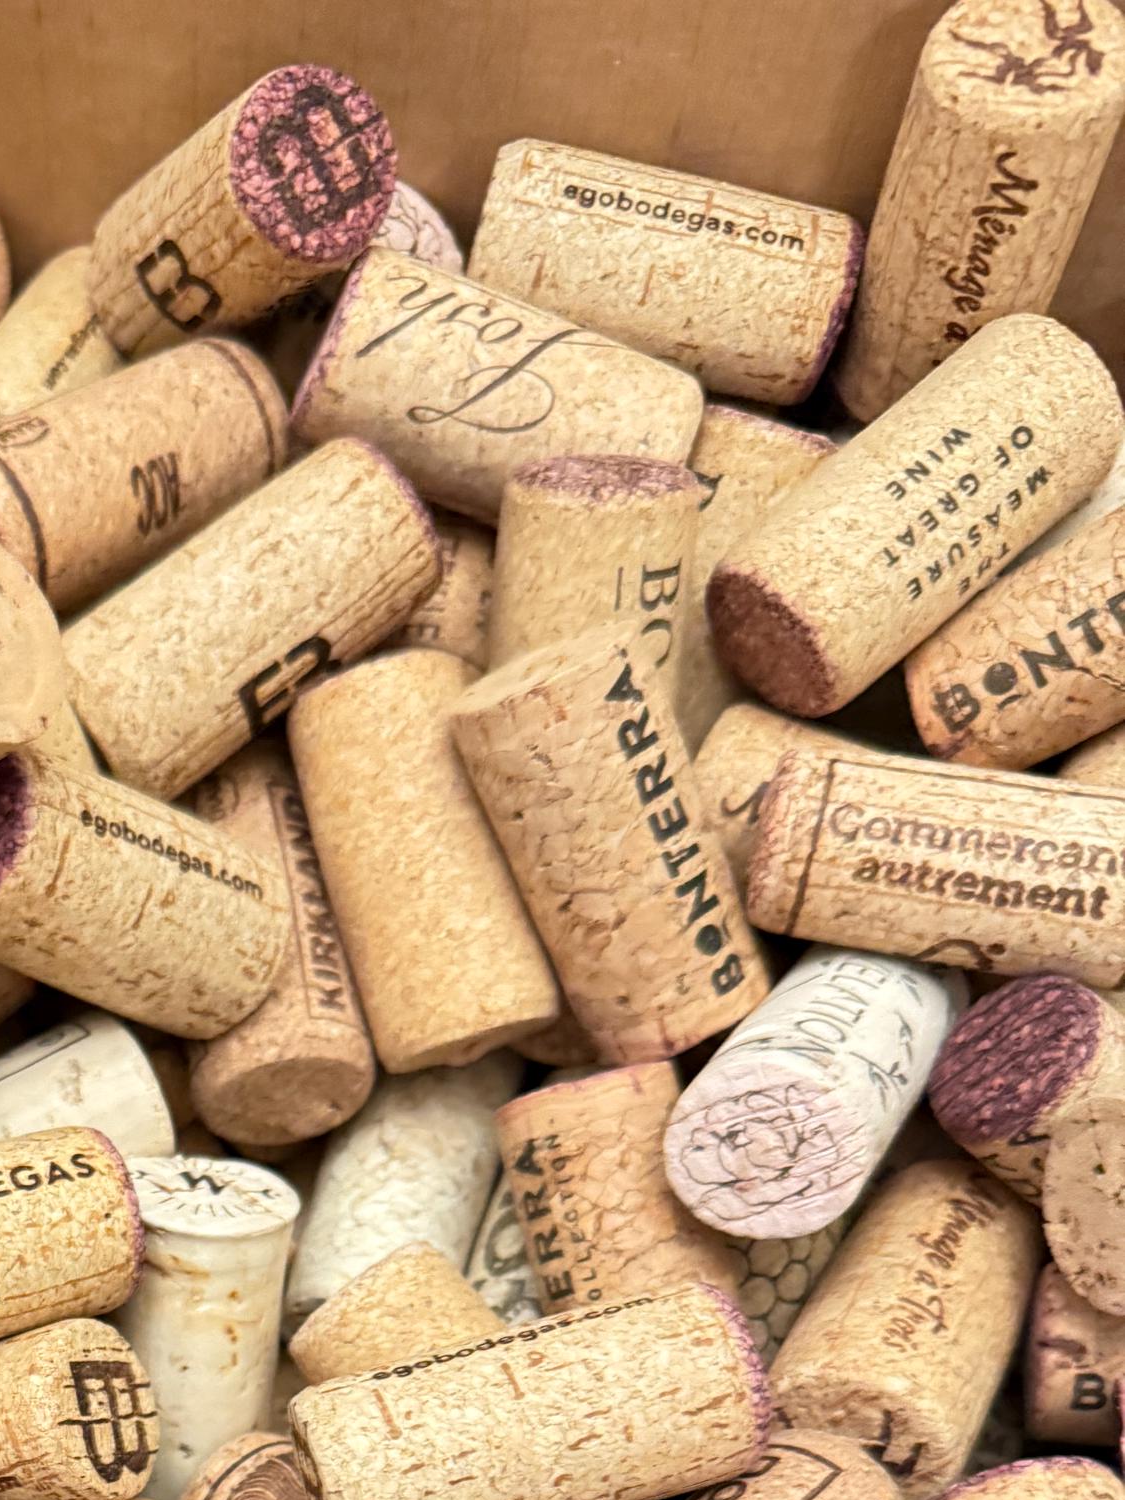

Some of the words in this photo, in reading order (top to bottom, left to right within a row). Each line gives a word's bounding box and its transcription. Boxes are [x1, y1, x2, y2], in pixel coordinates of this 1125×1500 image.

[563, 182, 806, 252] egobodegas.com
[356, 275, 627, 434] Josh
[885, 428, 972, 500] WINE
[994, 425, 1034, 469] OF
[884, 473, 980, 567] GREAT
[906, 466, 1053, 600] MEASURE
[80, 808, 264, 901] egobodegas.com
[604, 663, 744, 997] BONTERRA
[853, 852, 1110, 920] autrement
[371, 1295, 656, 1382] egobodegas.com
